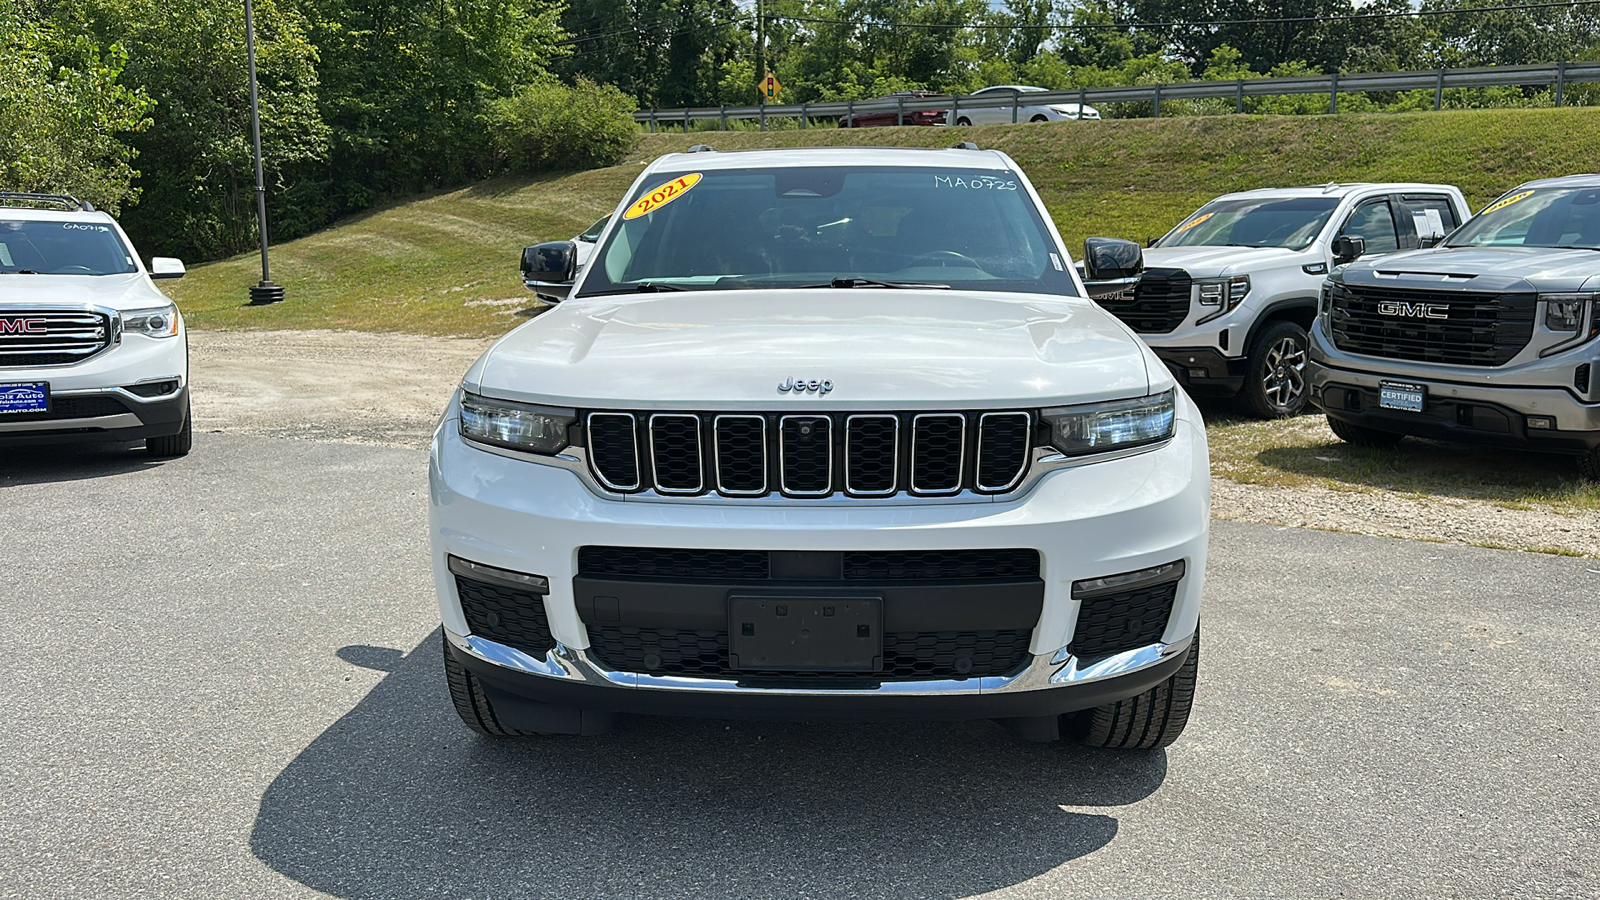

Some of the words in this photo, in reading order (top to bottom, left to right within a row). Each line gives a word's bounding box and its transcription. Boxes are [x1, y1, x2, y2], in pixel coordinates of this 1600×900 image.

[934, 175, 1017, 190] MA0725
[638, 178, 690, 212] 2021
[1378, 301, 1450, 319] GMC
[0, 318, 47, 333] MC
[777, 376, 834, 396] Jeep
[1381, 391, 1422, 402] CERTIFIED
